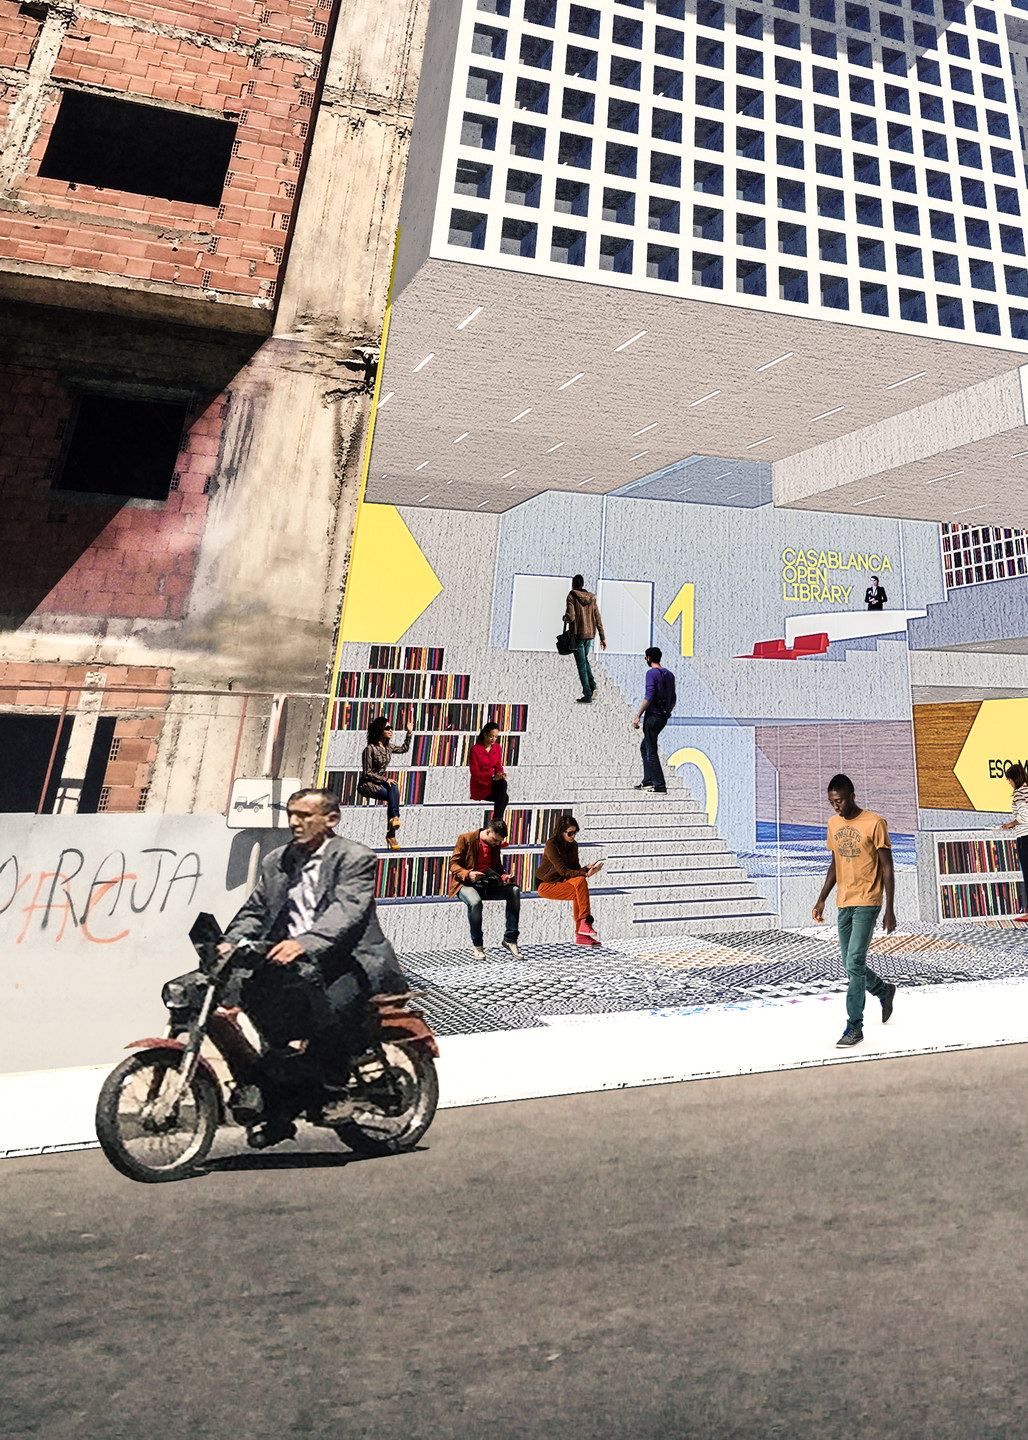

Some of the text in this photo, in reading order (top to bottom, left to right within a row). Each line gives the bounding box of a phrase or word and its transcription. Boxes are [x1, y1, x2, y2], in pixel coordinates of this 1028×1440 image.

[781, 548, 893, 572] CASABLANCA
[782, 565, 827, 584] OPEN
[783, 582, 852, 603] LIBRARY
[662, 583, 695, 657] 1
[41, 848, 203, 930] RAJA
